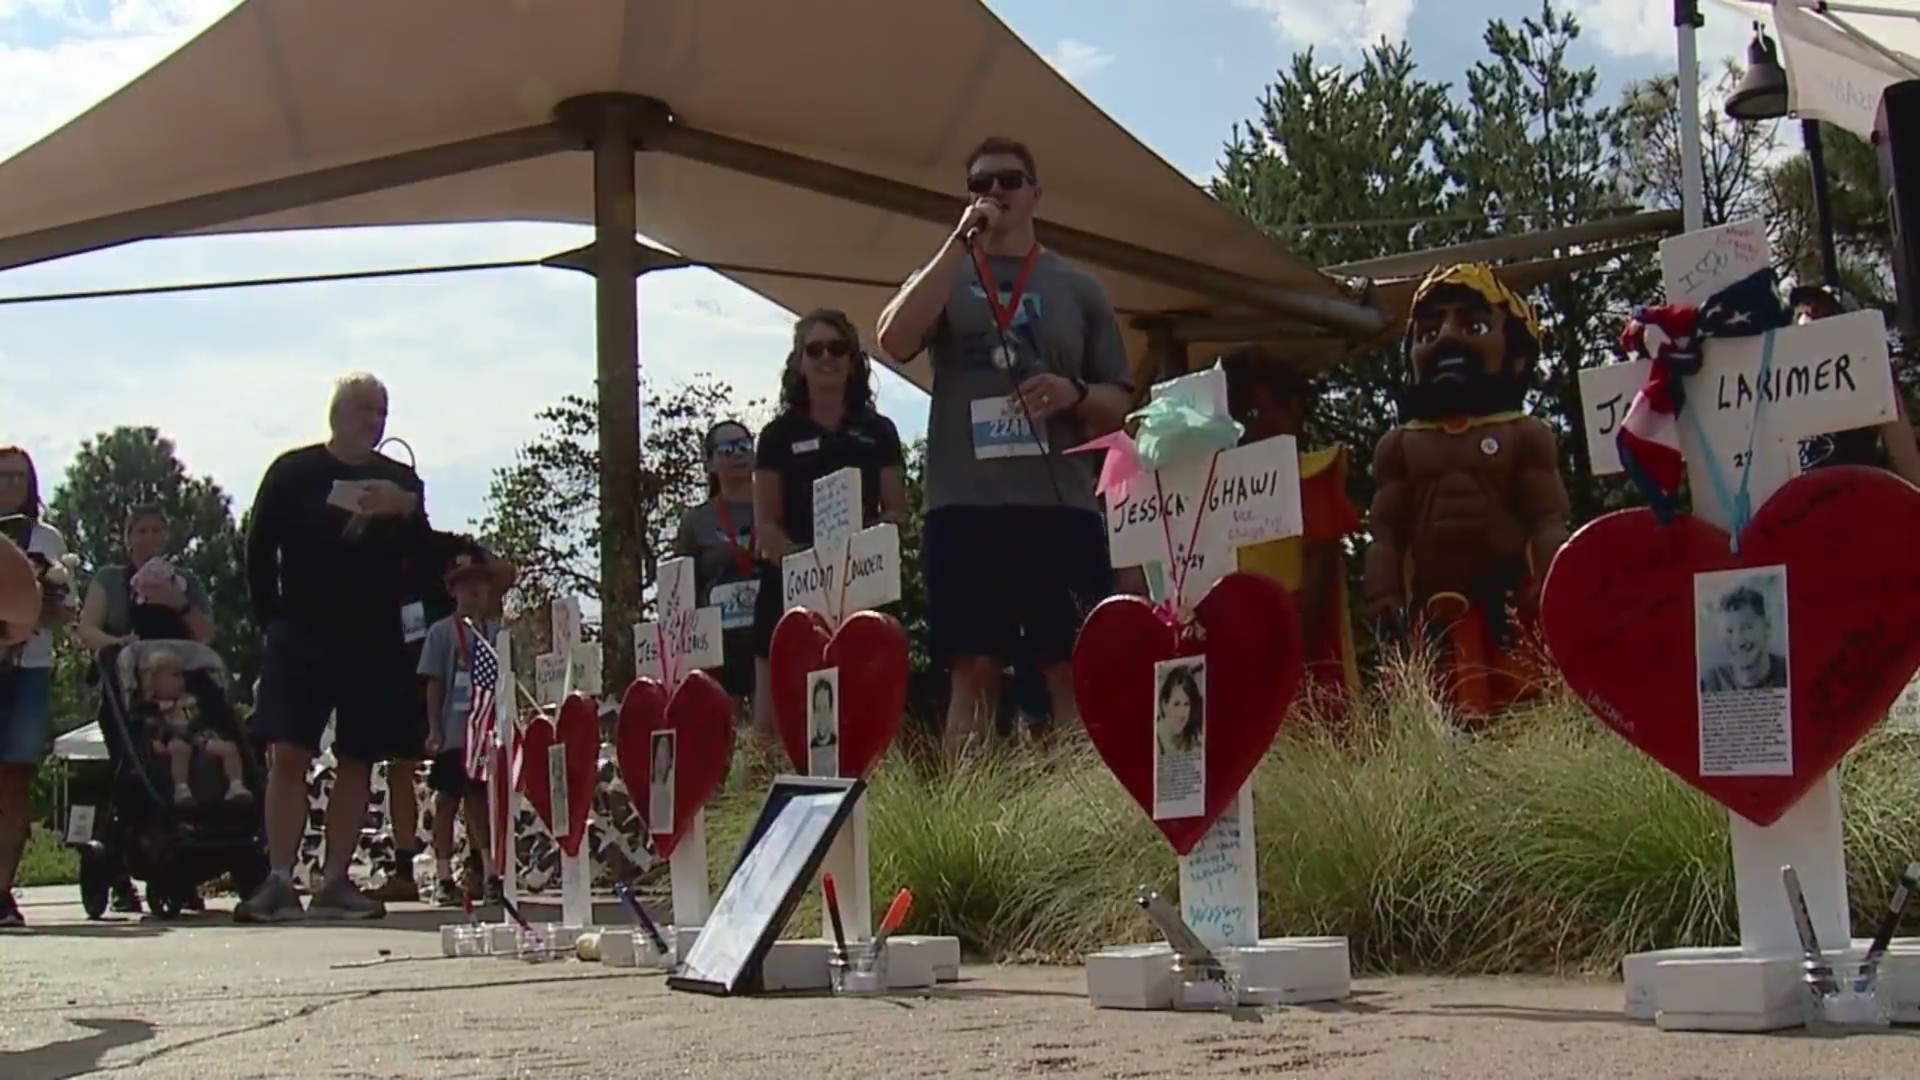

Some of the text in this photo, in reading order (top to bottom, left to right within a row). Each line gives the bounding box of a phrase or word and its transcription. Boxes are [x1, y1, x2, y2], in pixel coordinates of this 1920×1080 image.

[1717, 353, 1857, 411] LARIMER
[1113, 492, 1185, 534] JESSICA
[1207, 470, 1279, 512] GHAWI
